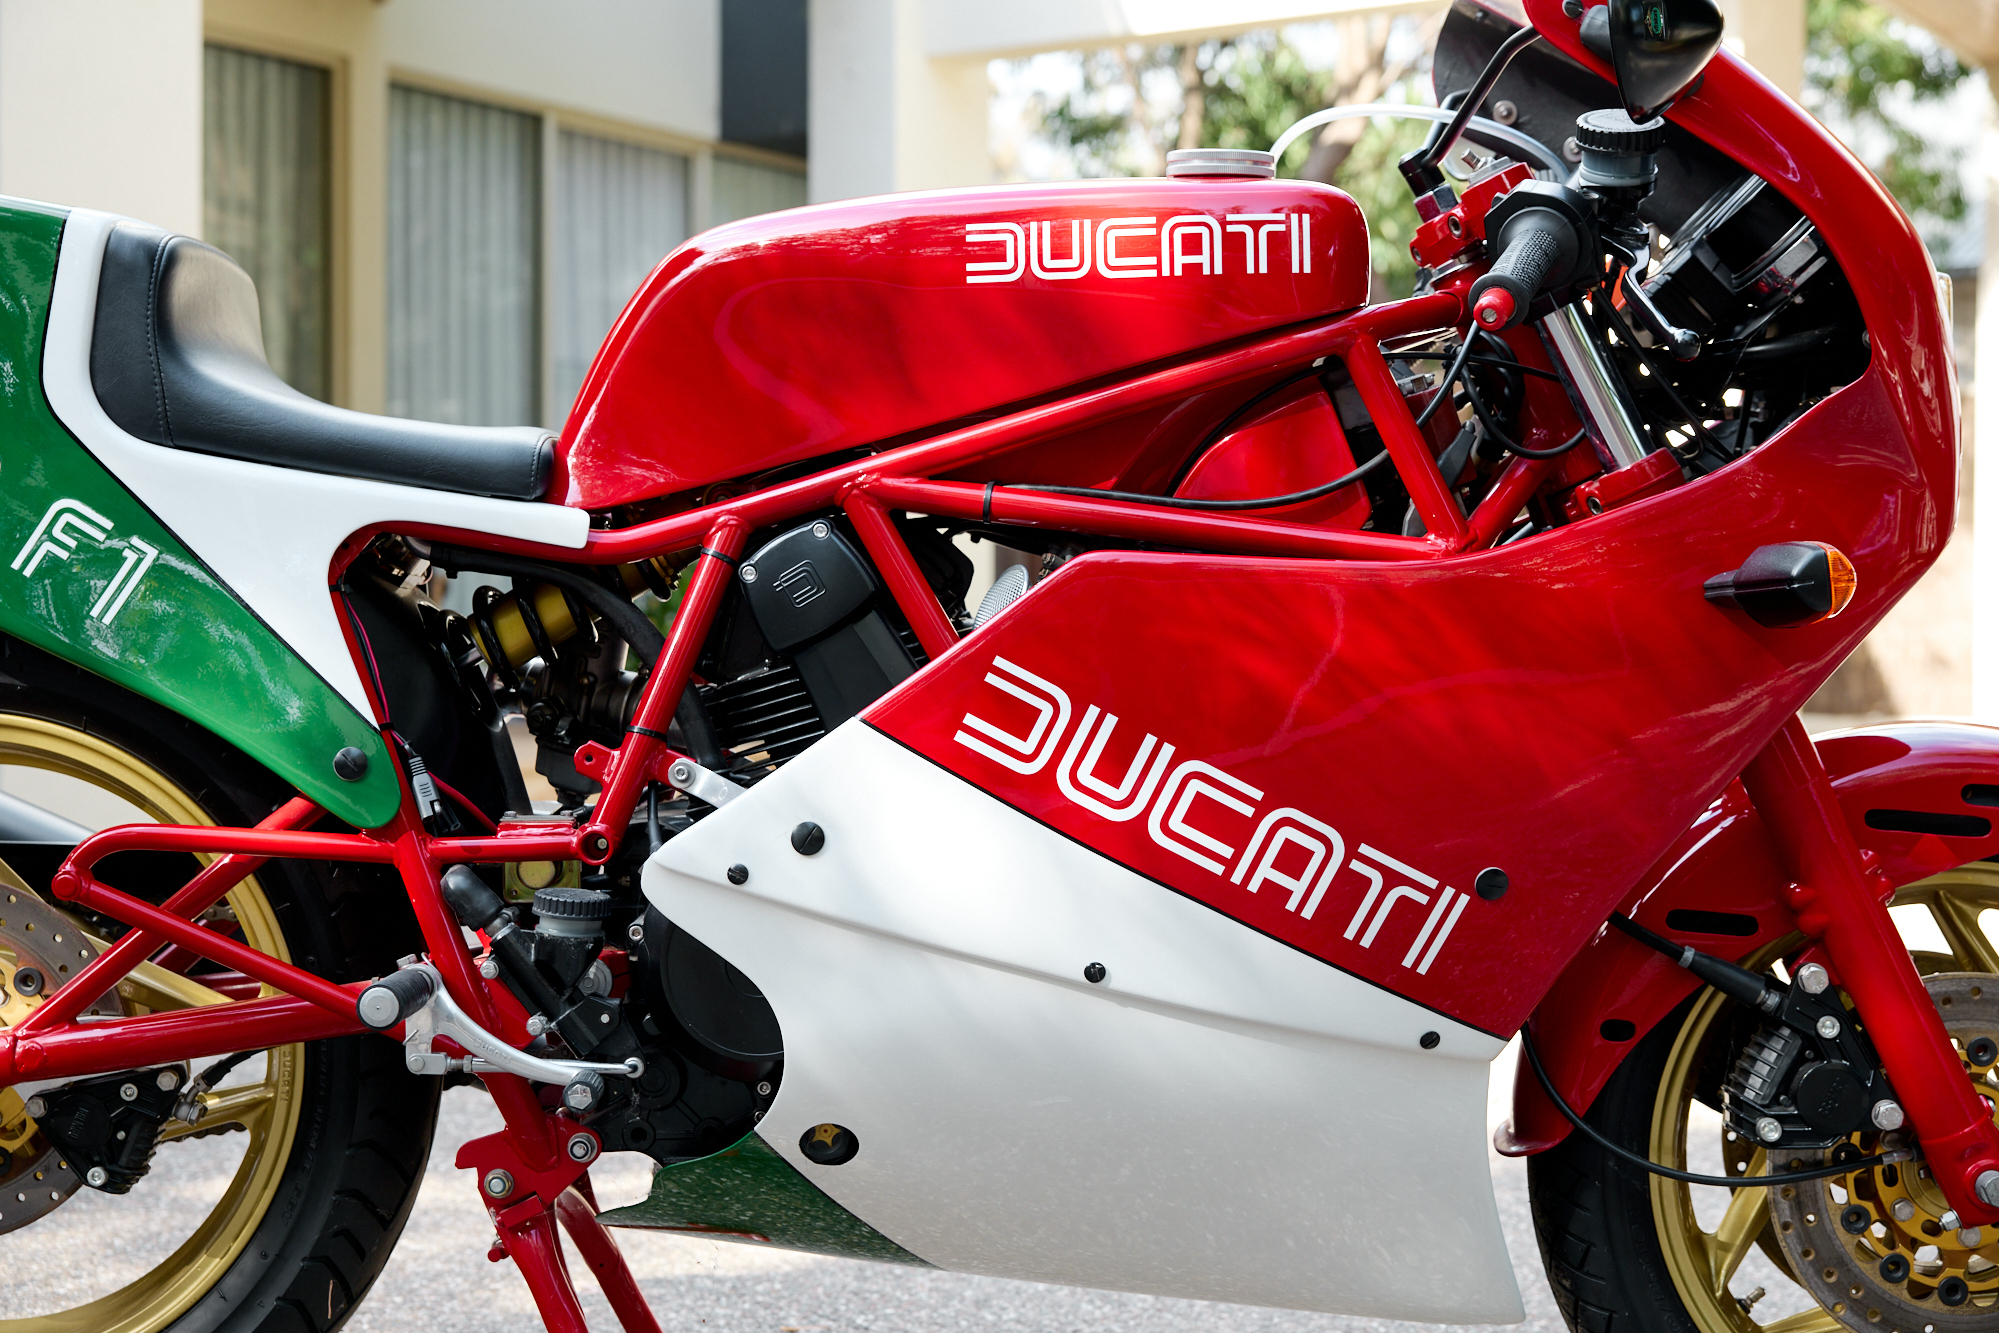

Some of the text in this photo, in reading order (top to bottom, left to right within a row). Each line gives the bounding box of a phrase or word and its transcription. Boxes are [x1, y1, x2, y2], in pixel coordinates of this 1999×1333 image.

[966, 214, 1310, 283] DUCATI
[11, 498, 159, 626] F1
[954, 655, 1471, 976] DUCATI
